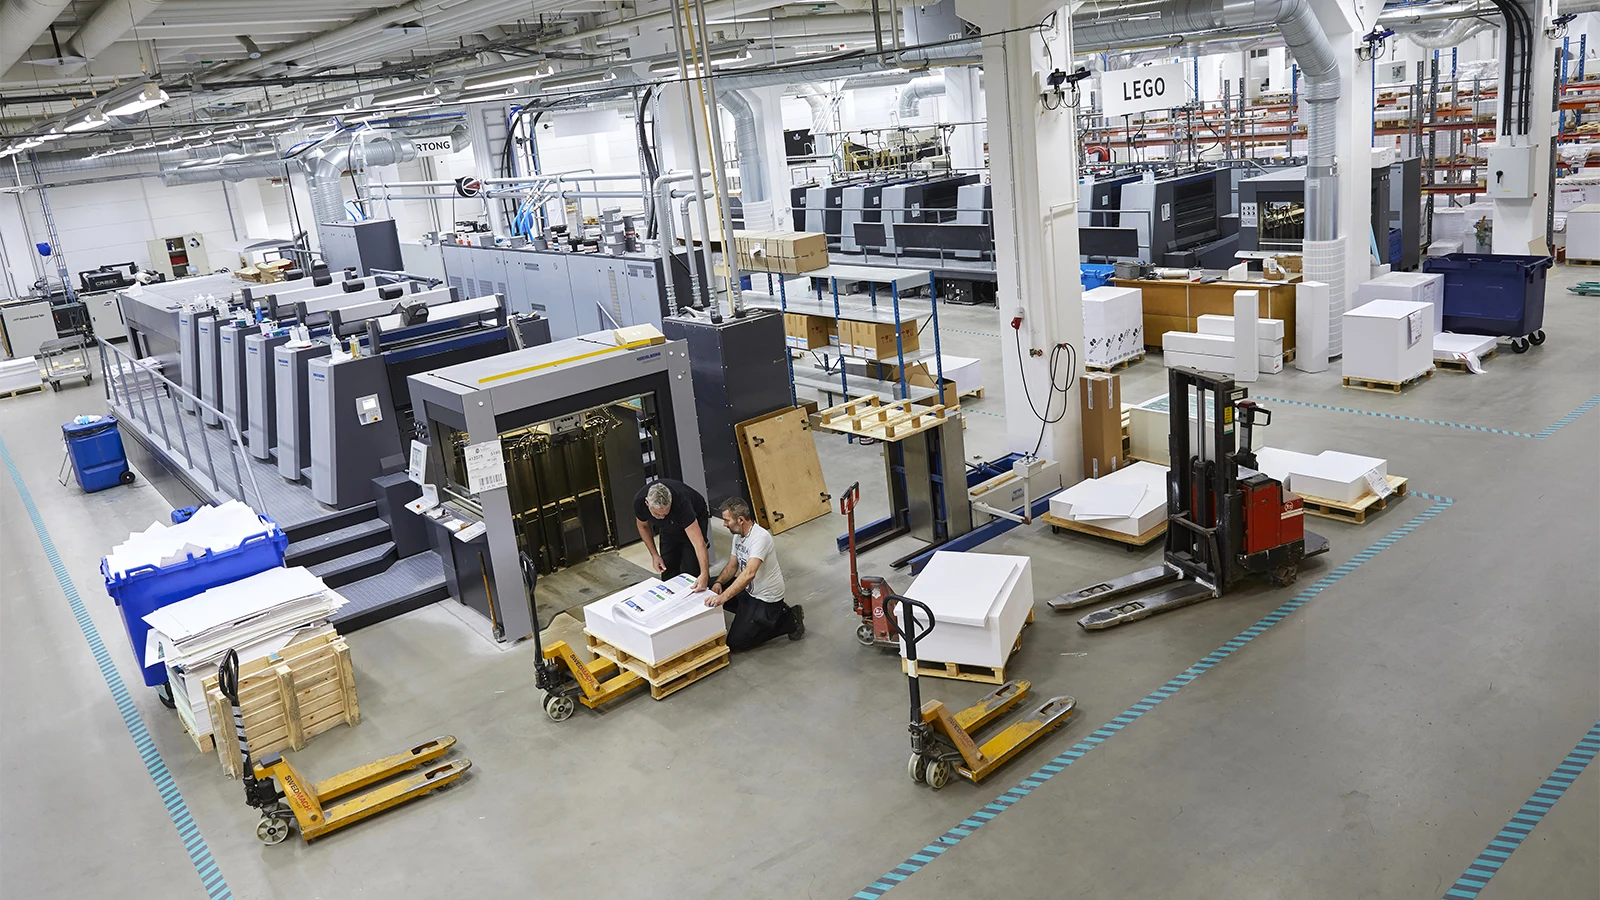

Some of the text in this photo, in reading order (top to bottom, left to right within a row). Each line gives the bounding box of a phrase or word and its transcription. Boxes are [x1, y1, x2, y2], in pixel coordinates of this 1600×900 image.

[1123, 77, 1165, 101] LEGO
[569, 654, 595, 684] SWEDMACH
[946, 716, 976, 750] SWEDMACH
[284, 774, 313, 812] SWEDMACH
